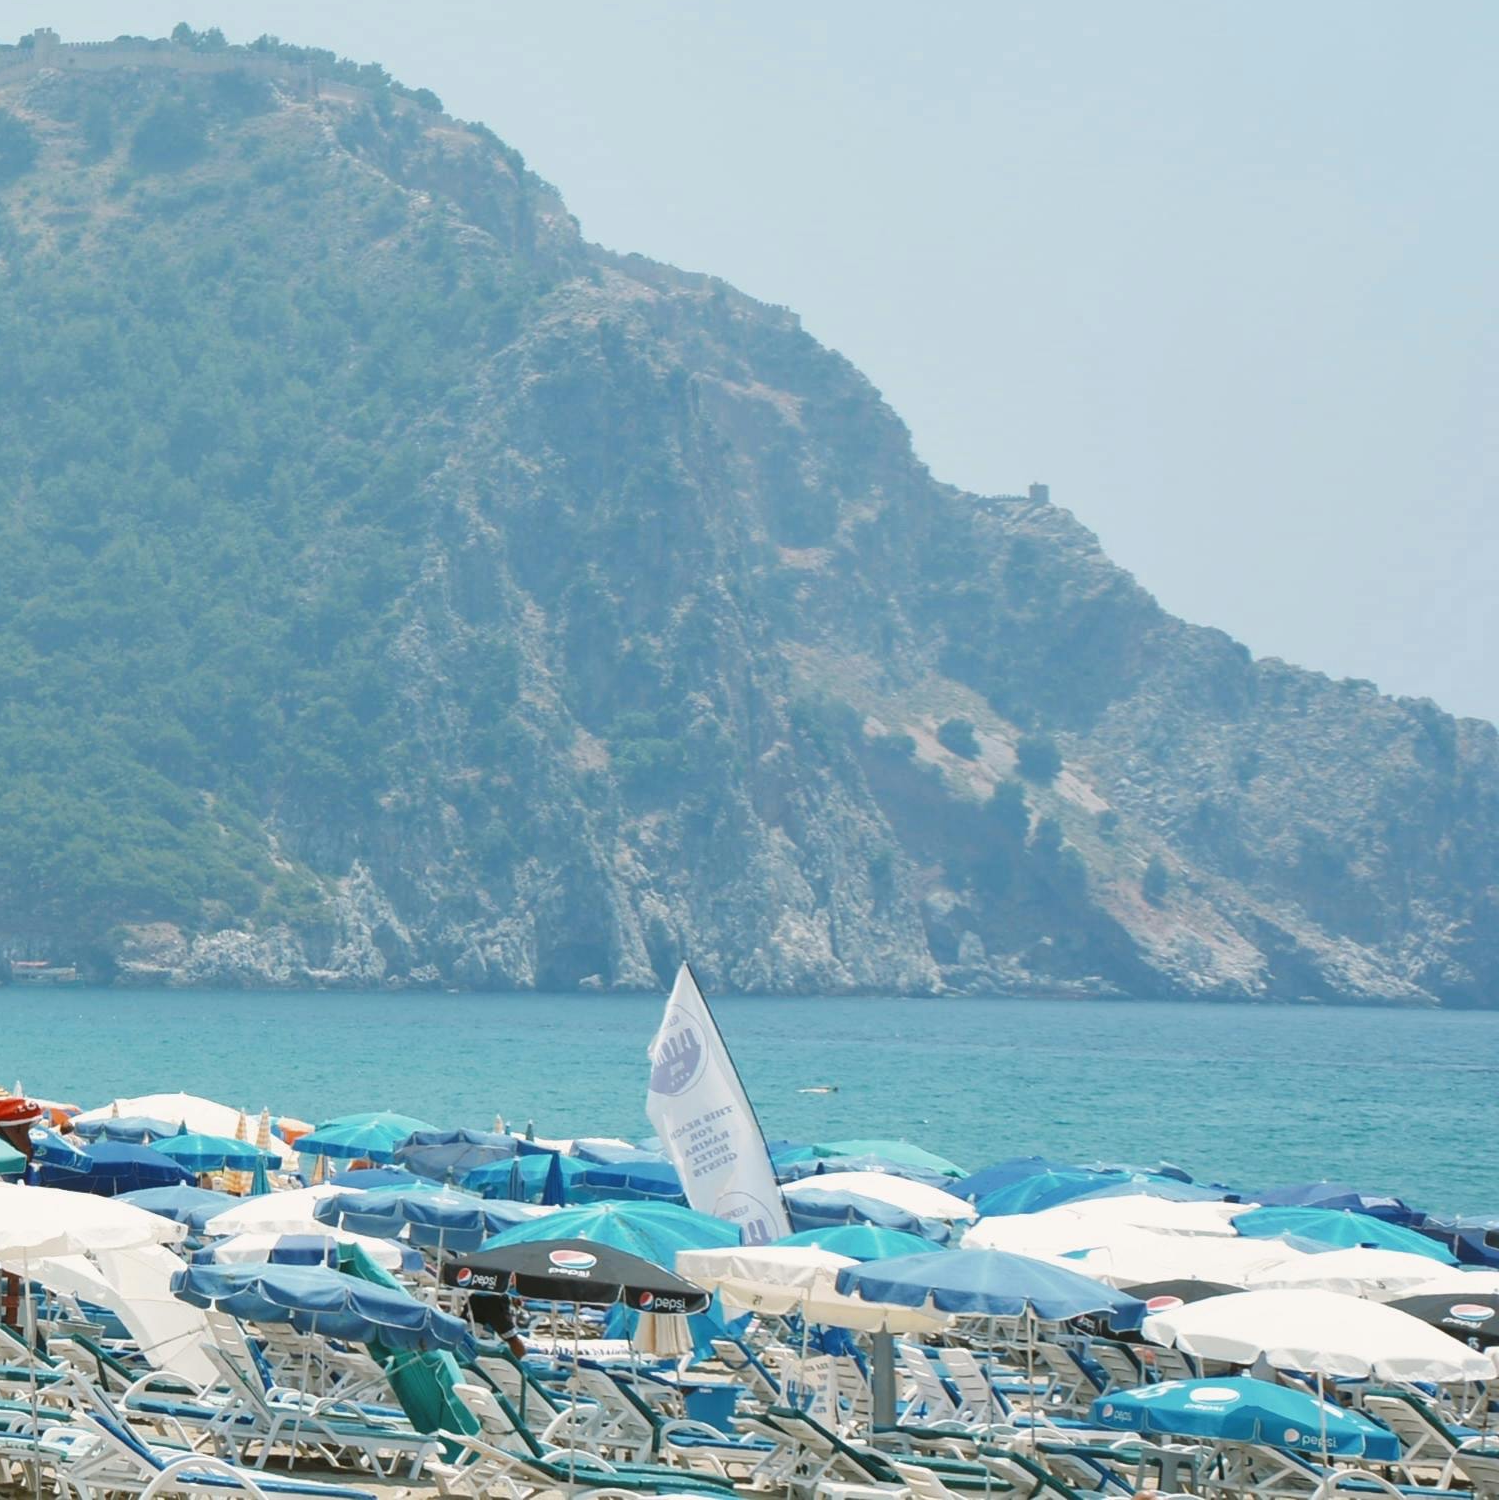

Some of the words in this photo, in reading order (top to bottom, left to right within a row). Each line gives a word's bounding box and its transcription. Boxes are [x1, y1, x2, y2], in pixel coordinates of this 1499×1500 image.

[472, 1274, 498, 1287] pepsi
[654, 1298, 687, 1311] pepsi
[1302, 1433, 1337, 1448] pepsi
